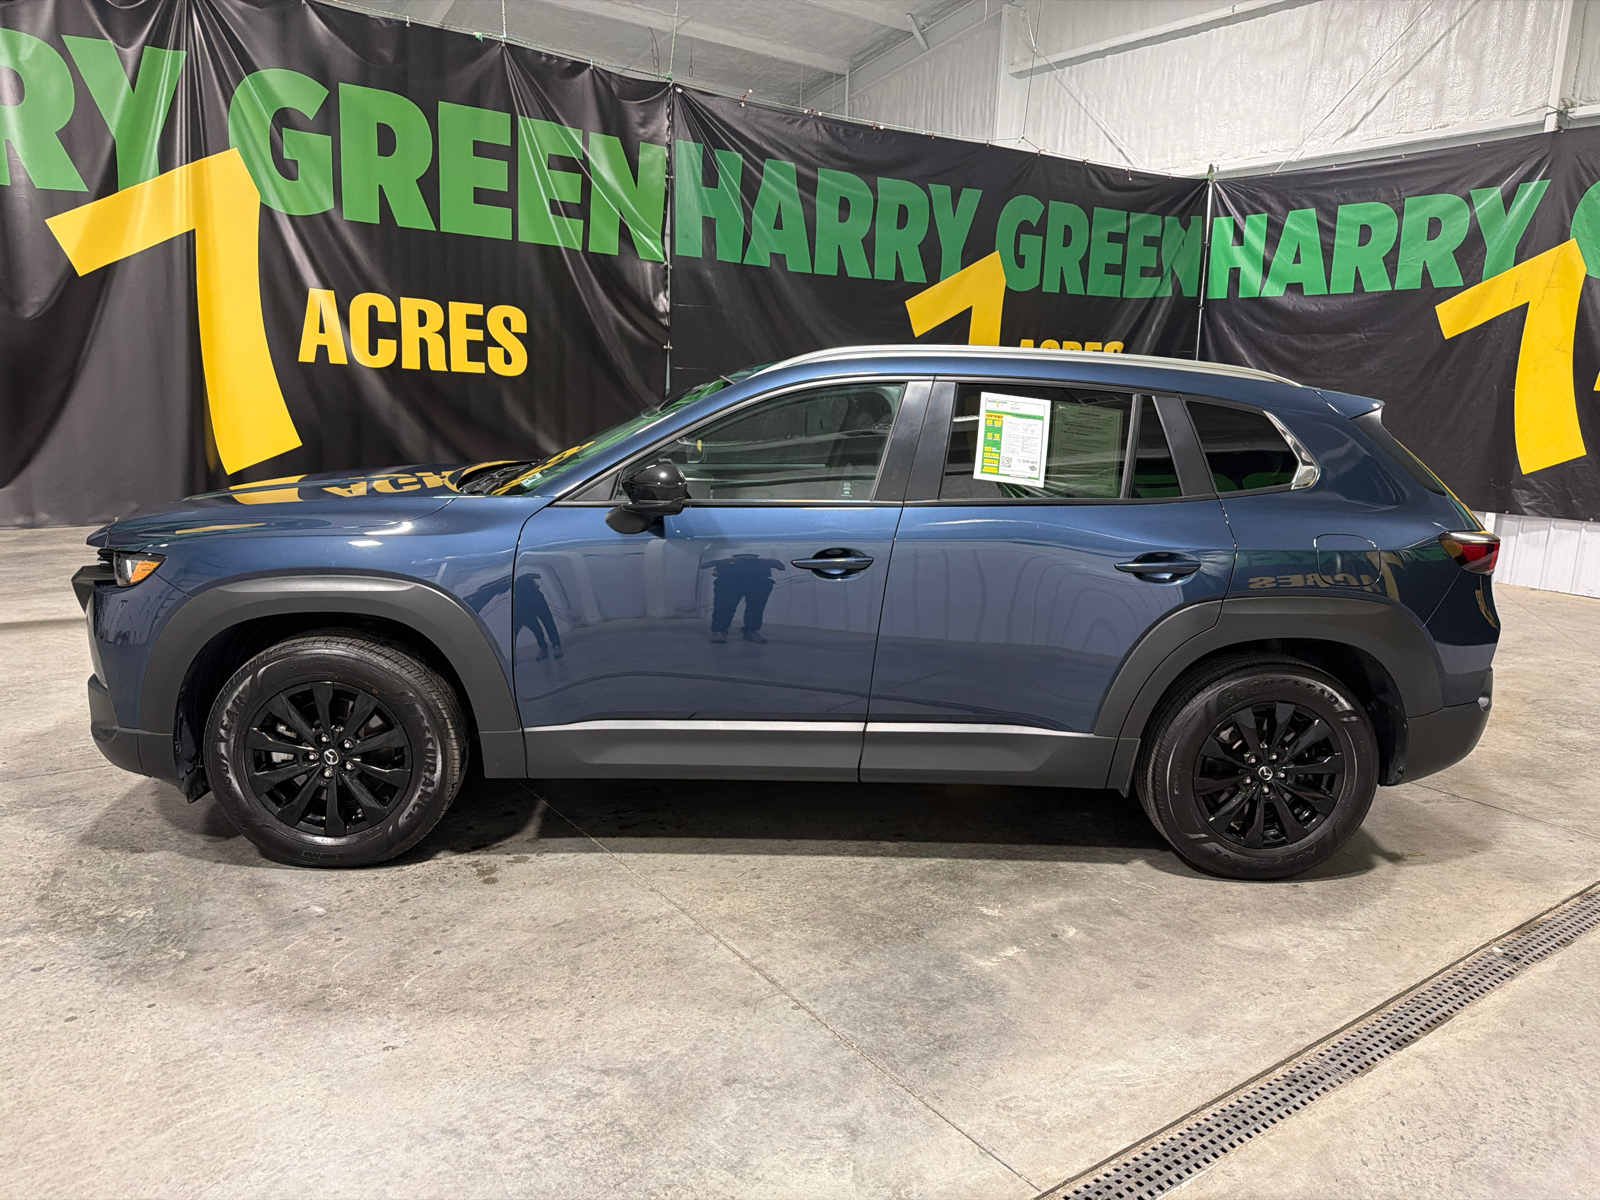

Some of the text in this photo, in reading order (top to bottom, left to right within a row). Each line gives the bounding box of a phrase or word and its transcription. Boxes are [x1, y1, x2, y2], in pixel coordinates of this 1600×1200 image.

[228, 68, 667, 262] GREEN
[675, 140, 1203, 299] HARRY GREEN
[1206, 179, 1552, 299] HARRY
[45, 147, 528, 475] 7 ACRES
[1434, 237, 1588, 476] 7
